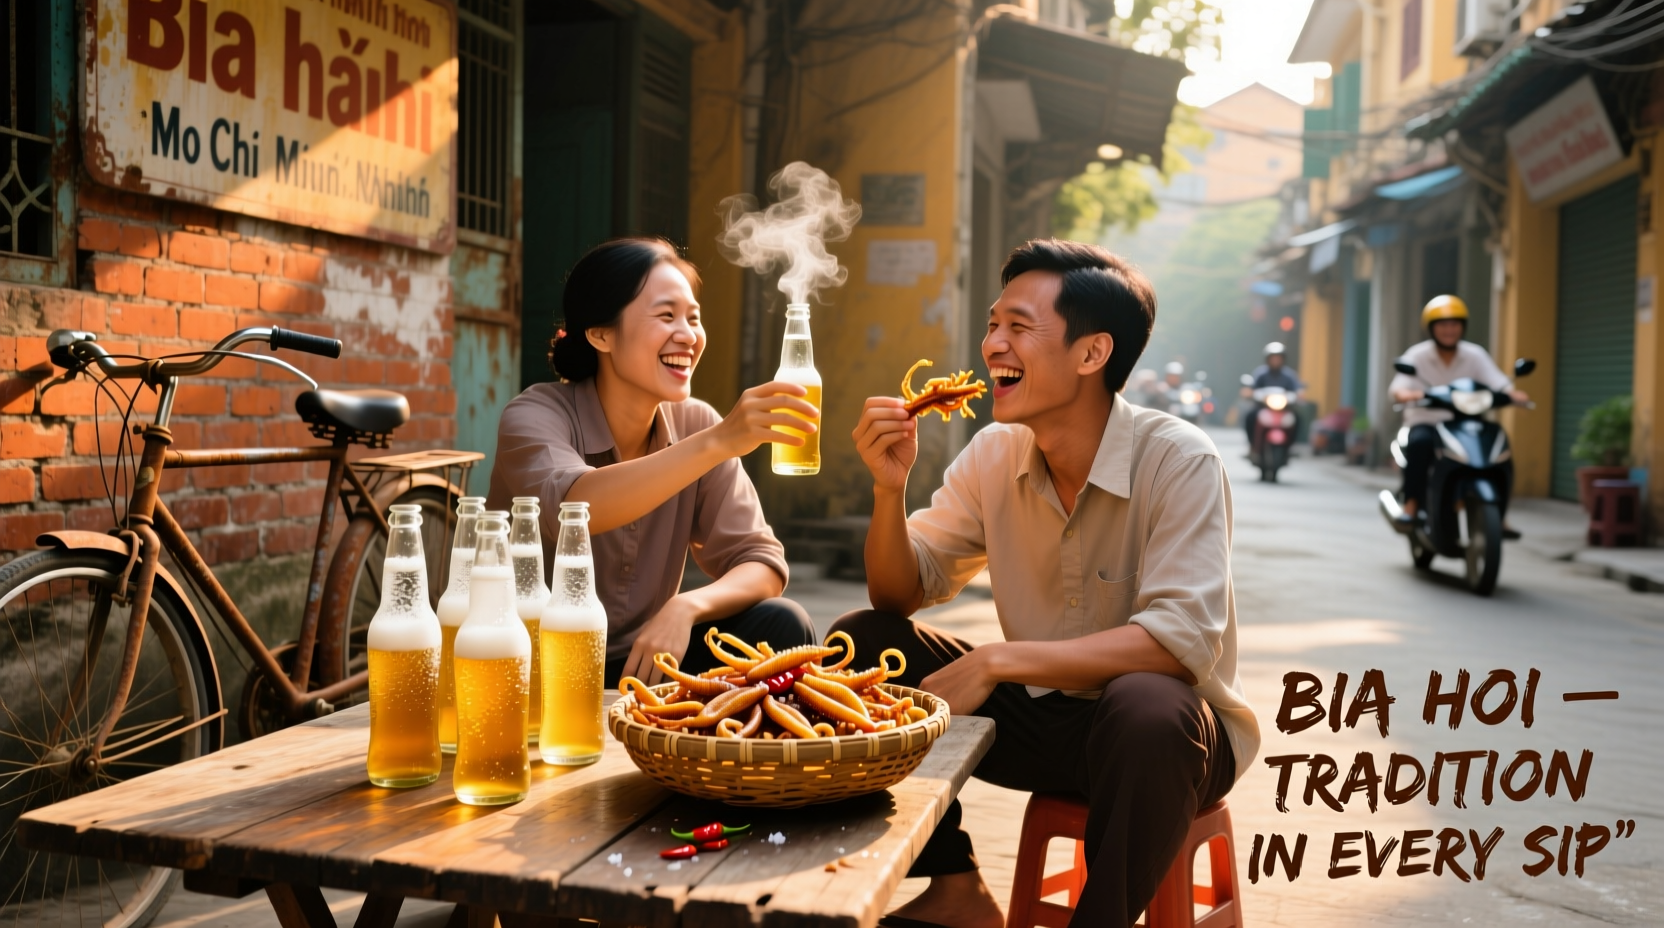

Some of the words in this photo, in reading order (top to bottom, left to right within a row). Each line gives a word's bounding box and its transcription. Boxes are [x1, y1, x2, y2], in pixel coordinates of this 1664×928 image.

[127, 0, 256, 99] Bia
[151, 101, 200, 164] Mo
[210, 117, 259, 178] Chi
